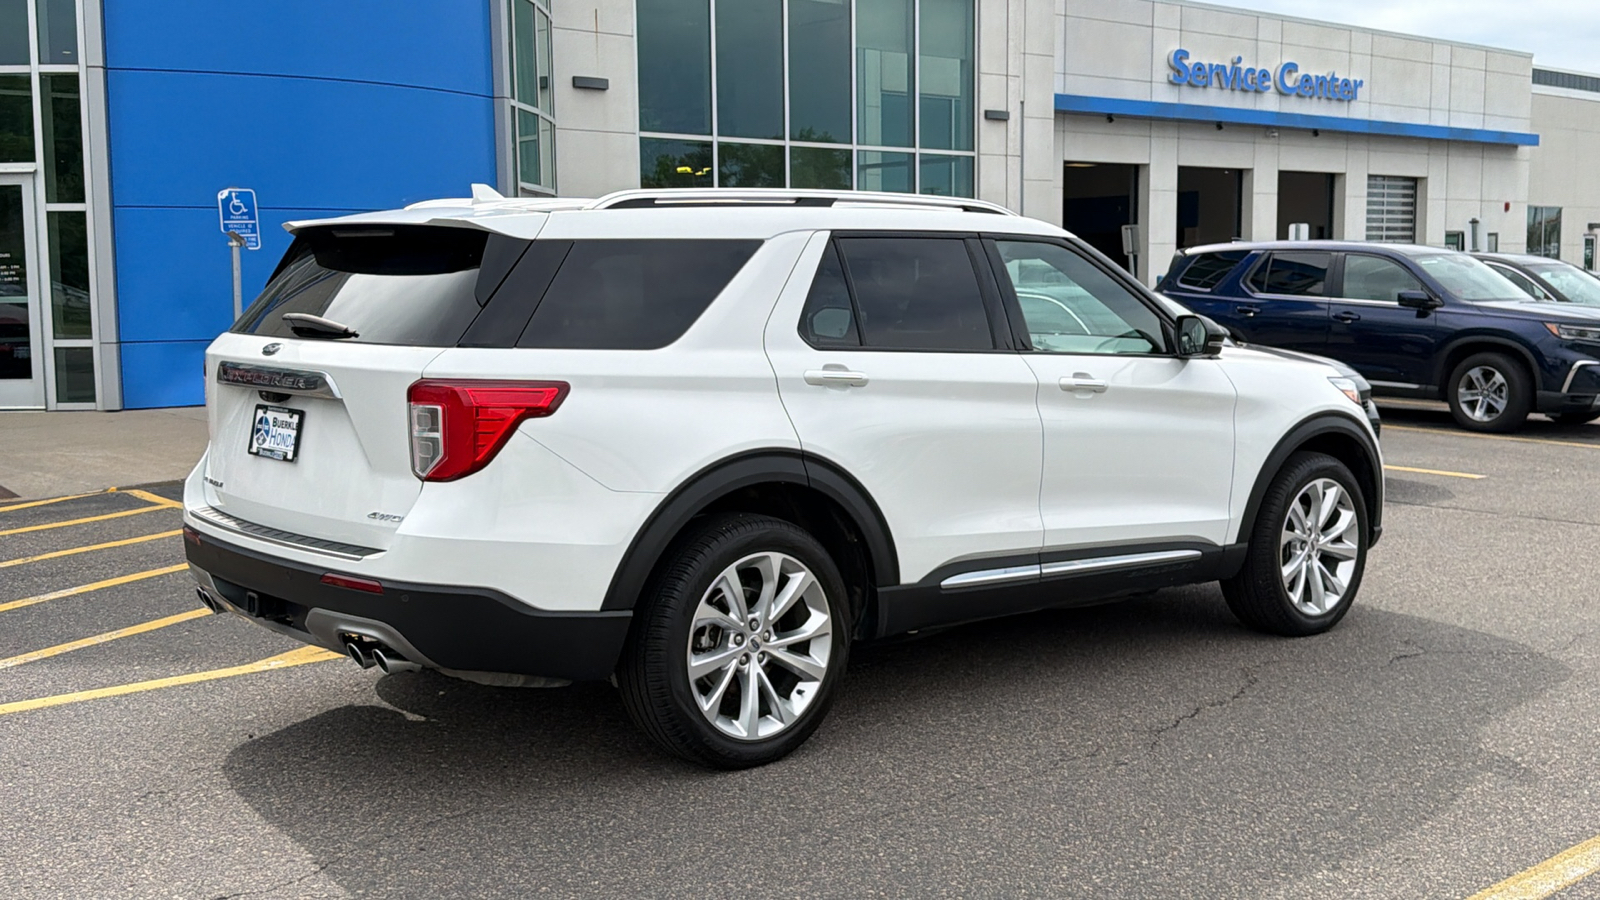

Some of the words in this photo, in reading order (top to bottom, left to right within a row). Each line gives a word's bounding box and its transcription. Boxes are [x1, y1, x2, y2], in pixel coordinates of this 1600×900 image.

[1169, 48, 1271, 92] Service
[1275, 62, 1364, 100] Center
[224, 369, 306, 388] EXPLORER
[272, 416, 299, 430] BUERKLE
[269, 428, 295, 448] HONDA
